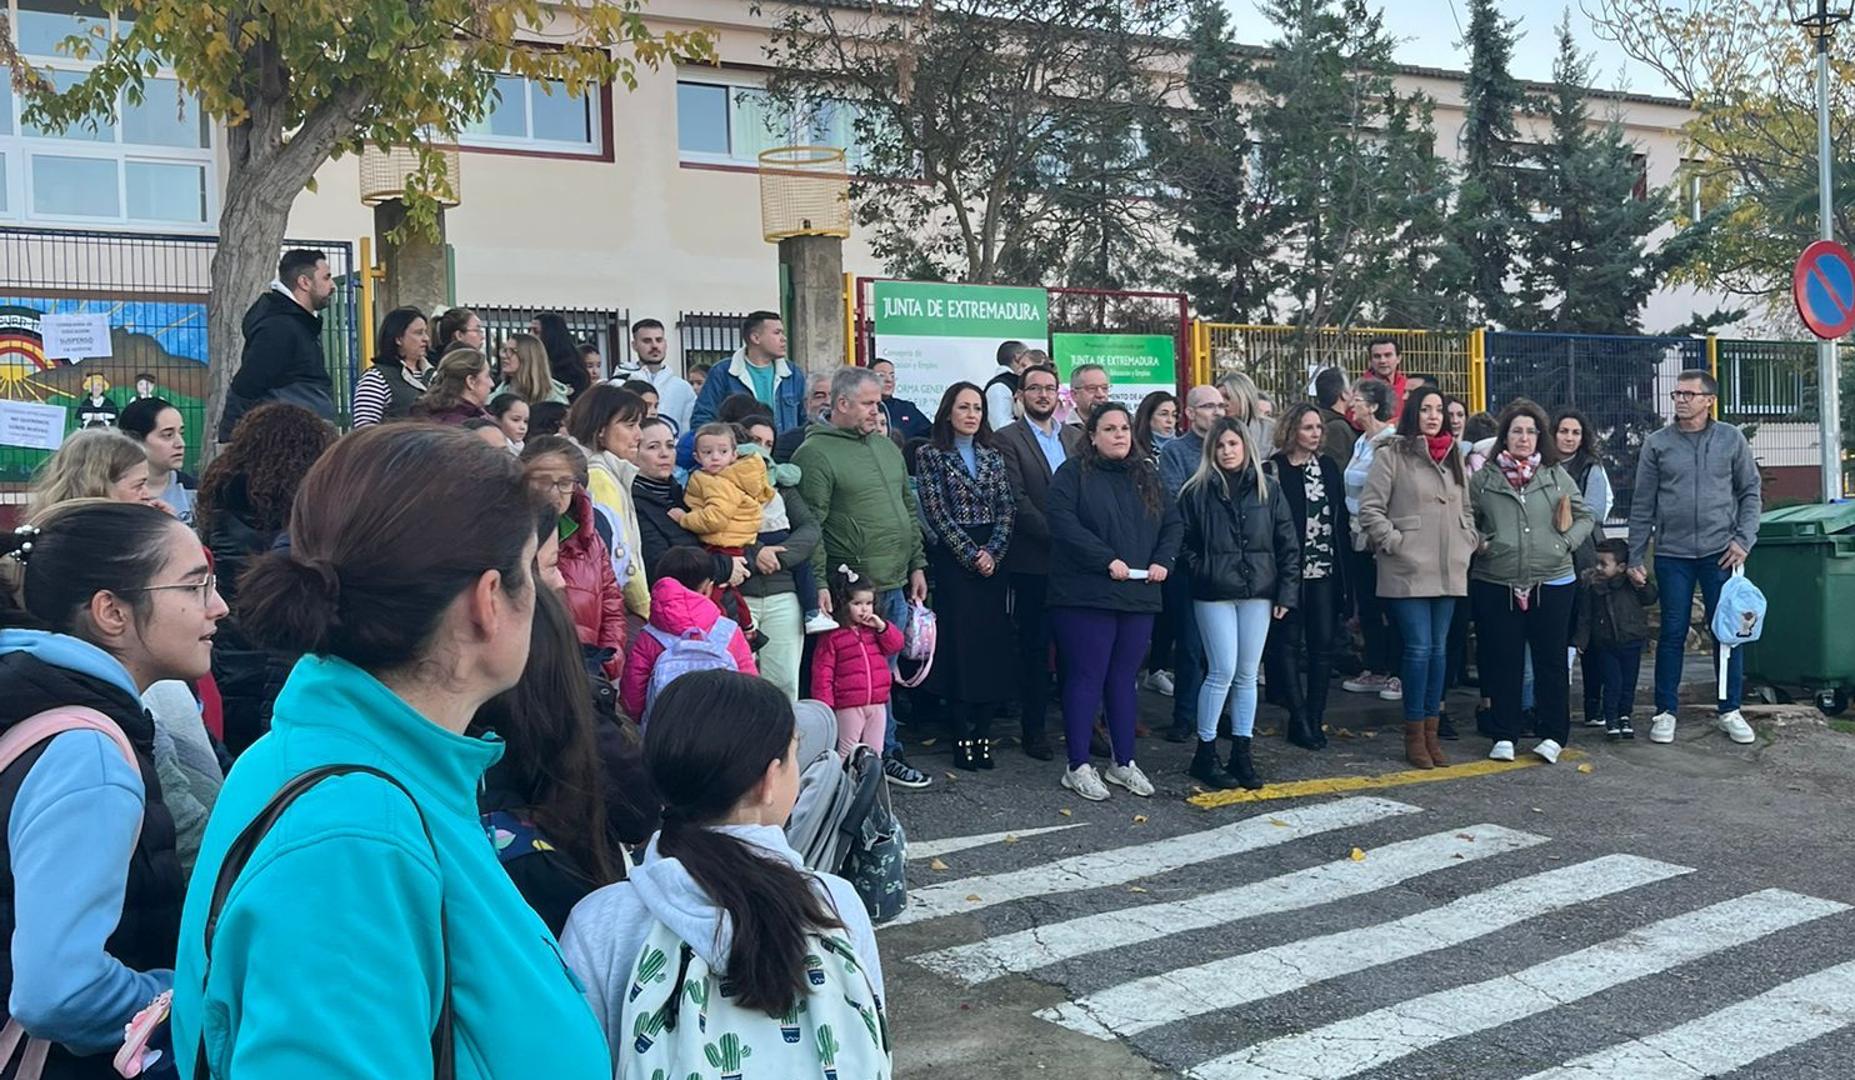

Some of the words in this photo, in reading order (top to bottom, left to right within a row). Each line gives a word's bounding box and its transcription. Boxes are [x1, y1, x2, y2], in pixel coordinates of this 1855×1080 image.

[882, 297, 923, 318] JUNTA
[928, 298, 944, 317] DE
[948, 300, 1040, 320] EXTREMADURA
[1071, 355, 1095, 367] JUNTA
[1096, 354, 1106, 366] DE
[1107, 355, 1159, 366] EXTREMADURA
